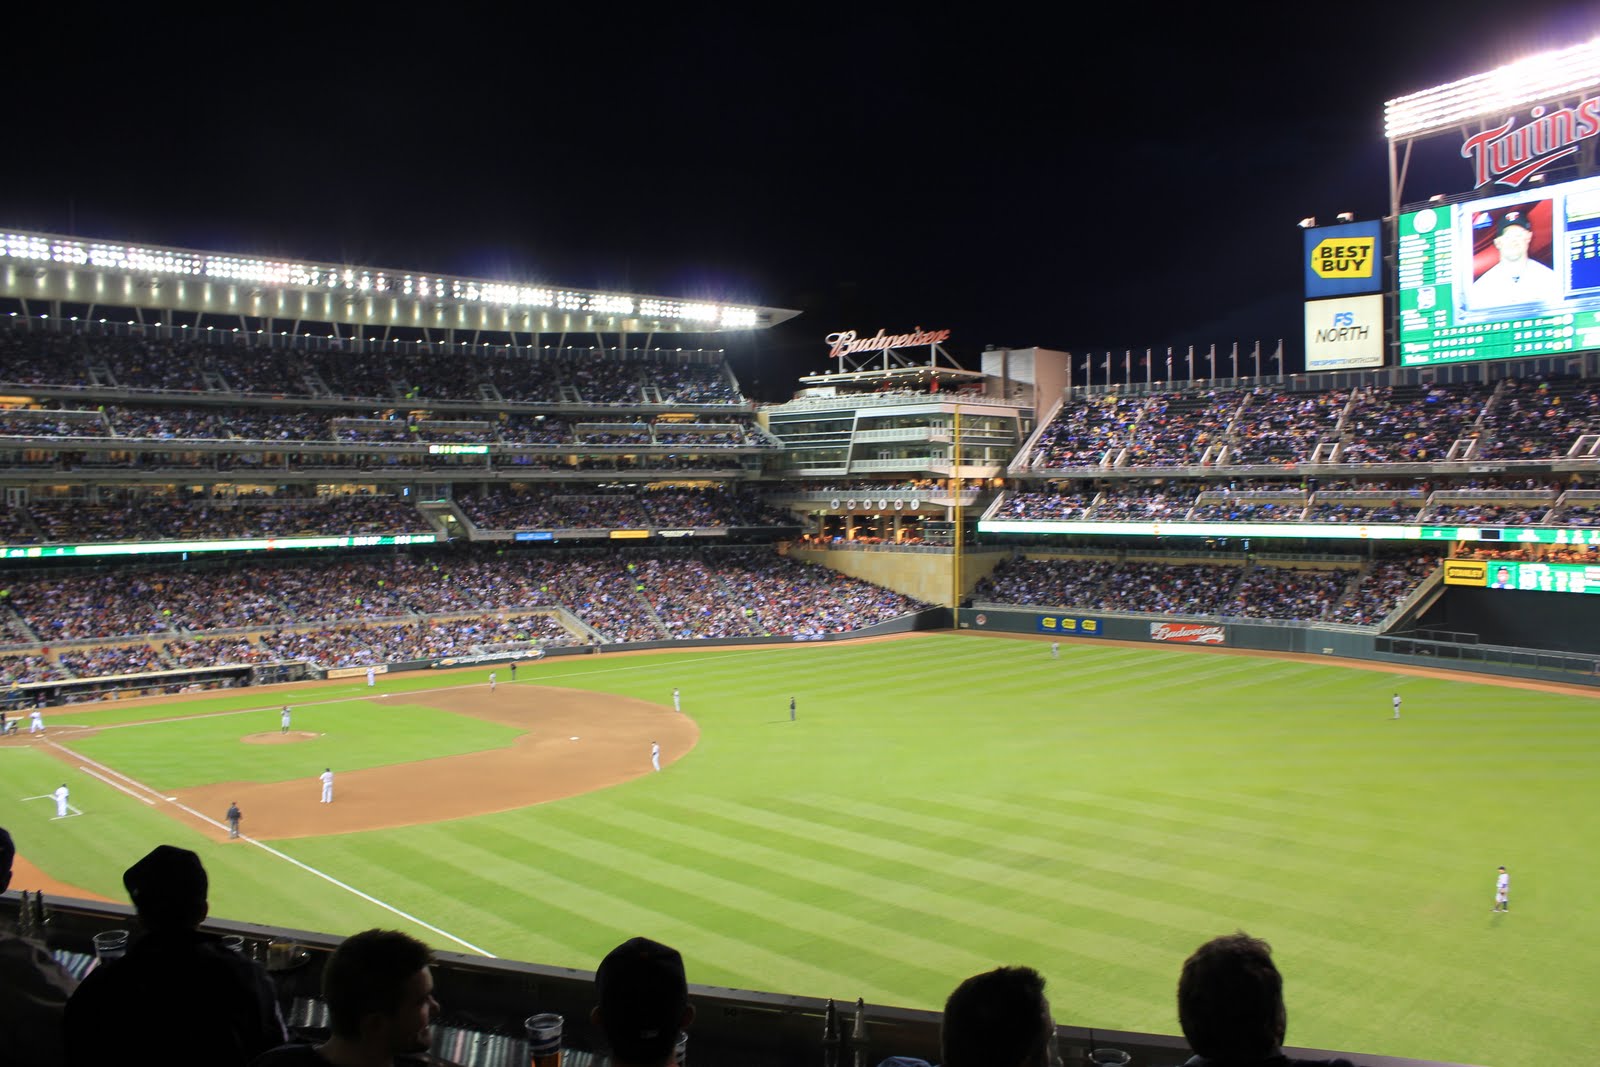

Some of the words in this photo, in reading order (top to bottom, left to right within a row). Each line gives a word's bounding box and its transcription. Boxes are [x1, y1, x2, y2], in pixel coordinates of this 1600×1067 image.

[1461, 96, 1600, 189] Twins
[1321, 245, 1370, 258] BEST
[1322, 259, 1366, 271] BUY
[1333, 311, 1354, 327] FS
[825, 326, 950, 358] Budweiser
[1315, 326, 1369, 343] NORTH
[1157, 624, 1220, 639] Budweiser
